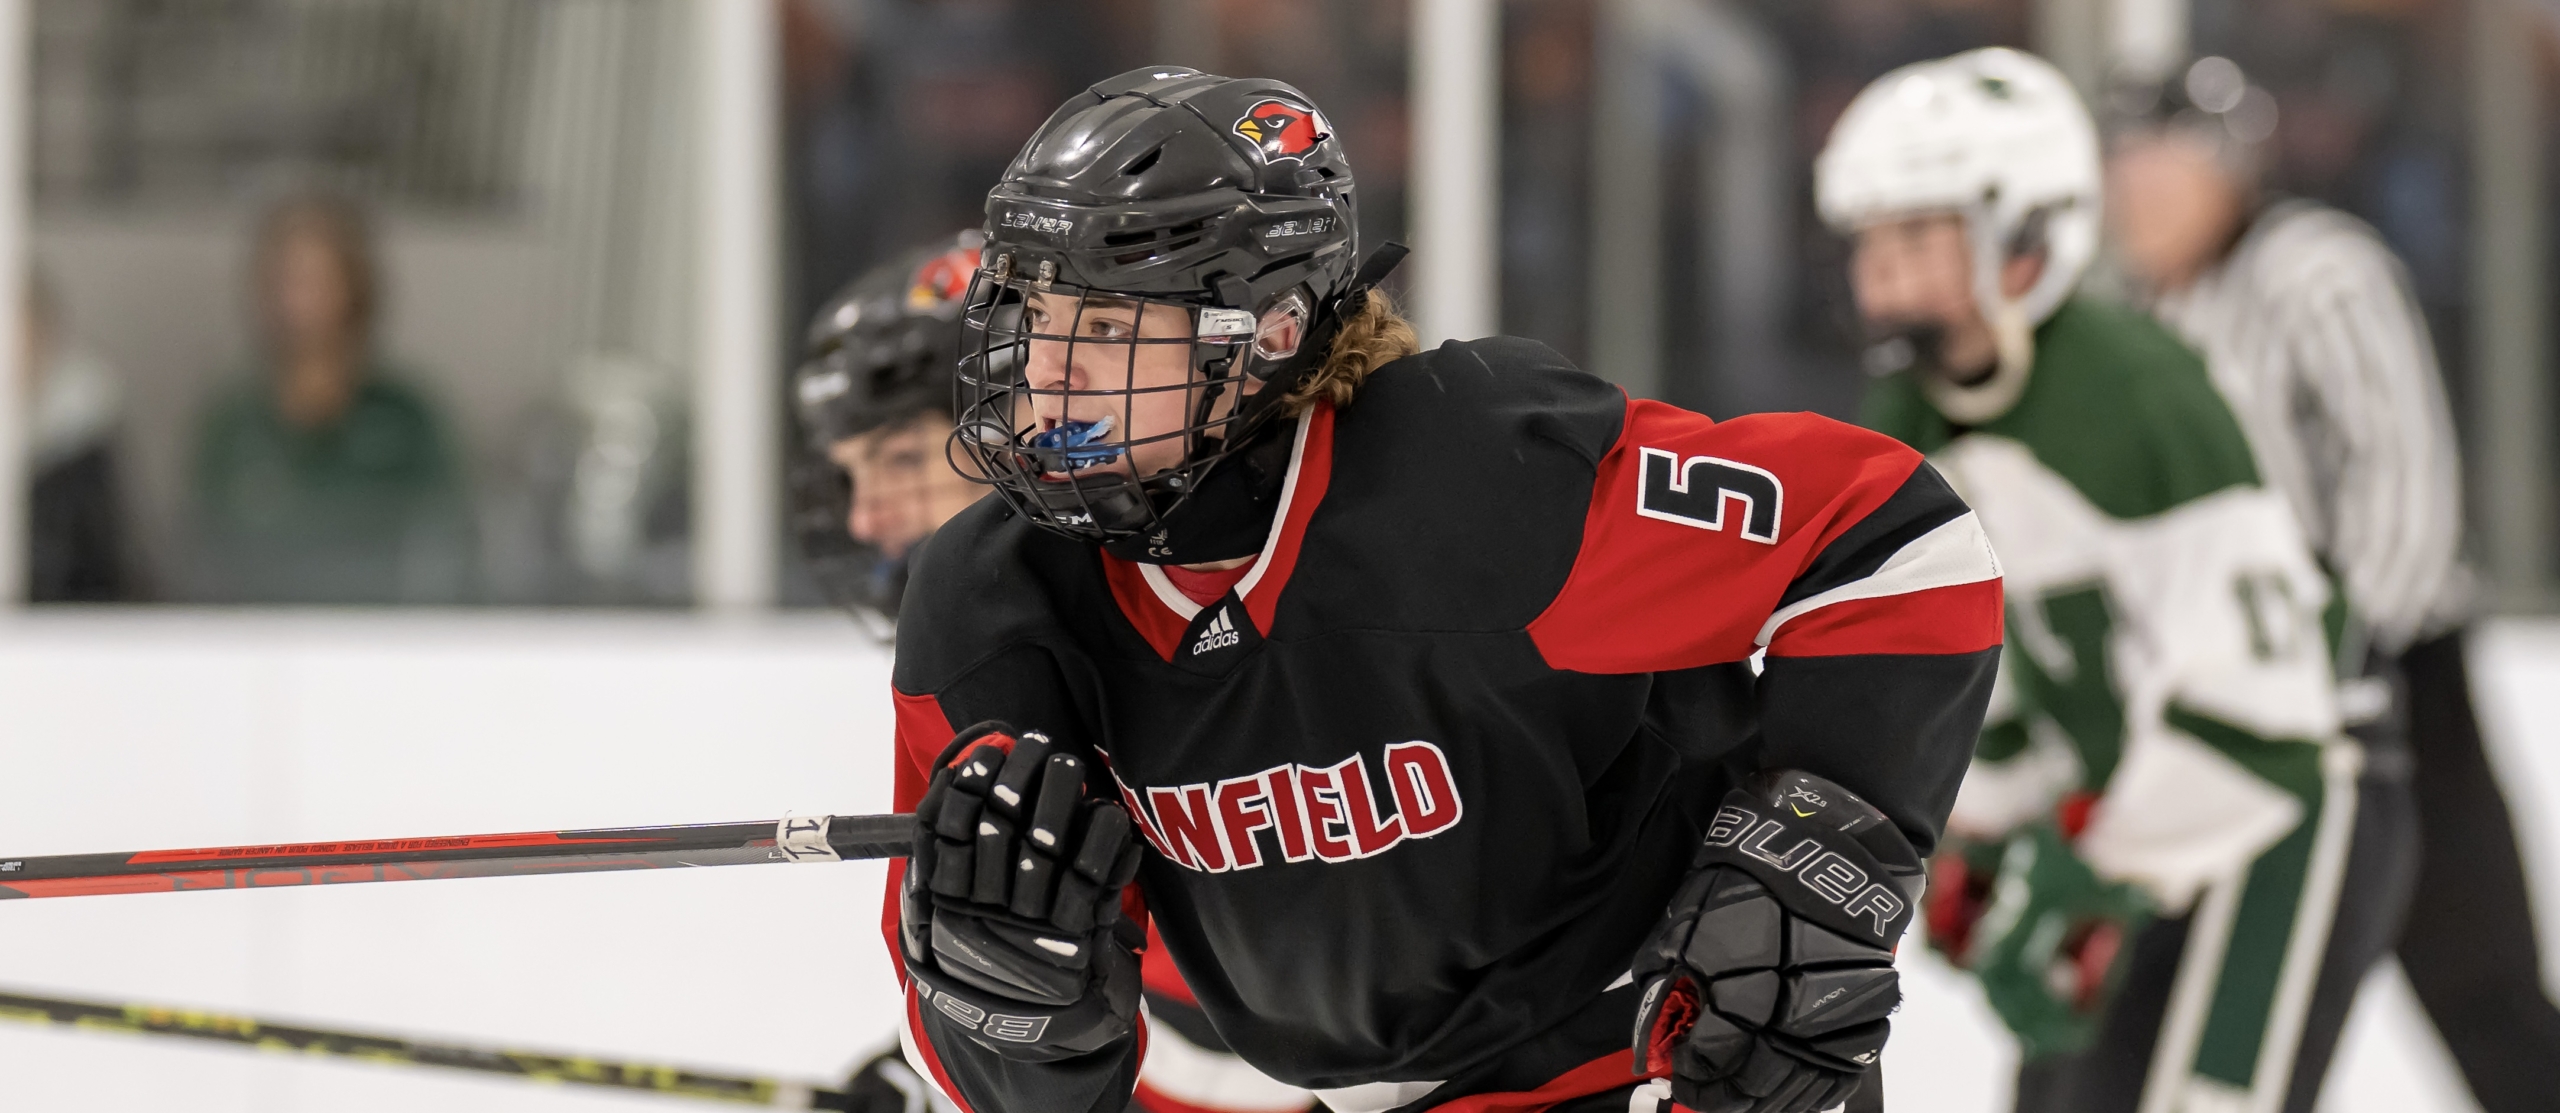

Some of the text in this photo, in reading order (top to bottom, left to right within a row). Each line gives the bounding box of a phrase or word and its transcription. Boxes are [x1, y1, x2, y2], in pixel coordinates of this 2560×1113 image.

[1636, 446, 1784, 545] 5
[1193, 630, 1239, 656] adidas
[342, 842, 375, 852] RELEASE
[376, 841, 400, 850] QUICK
[408, 840, 423, 849] FOR
[424, 838, 471, 848] ENGINEERED
